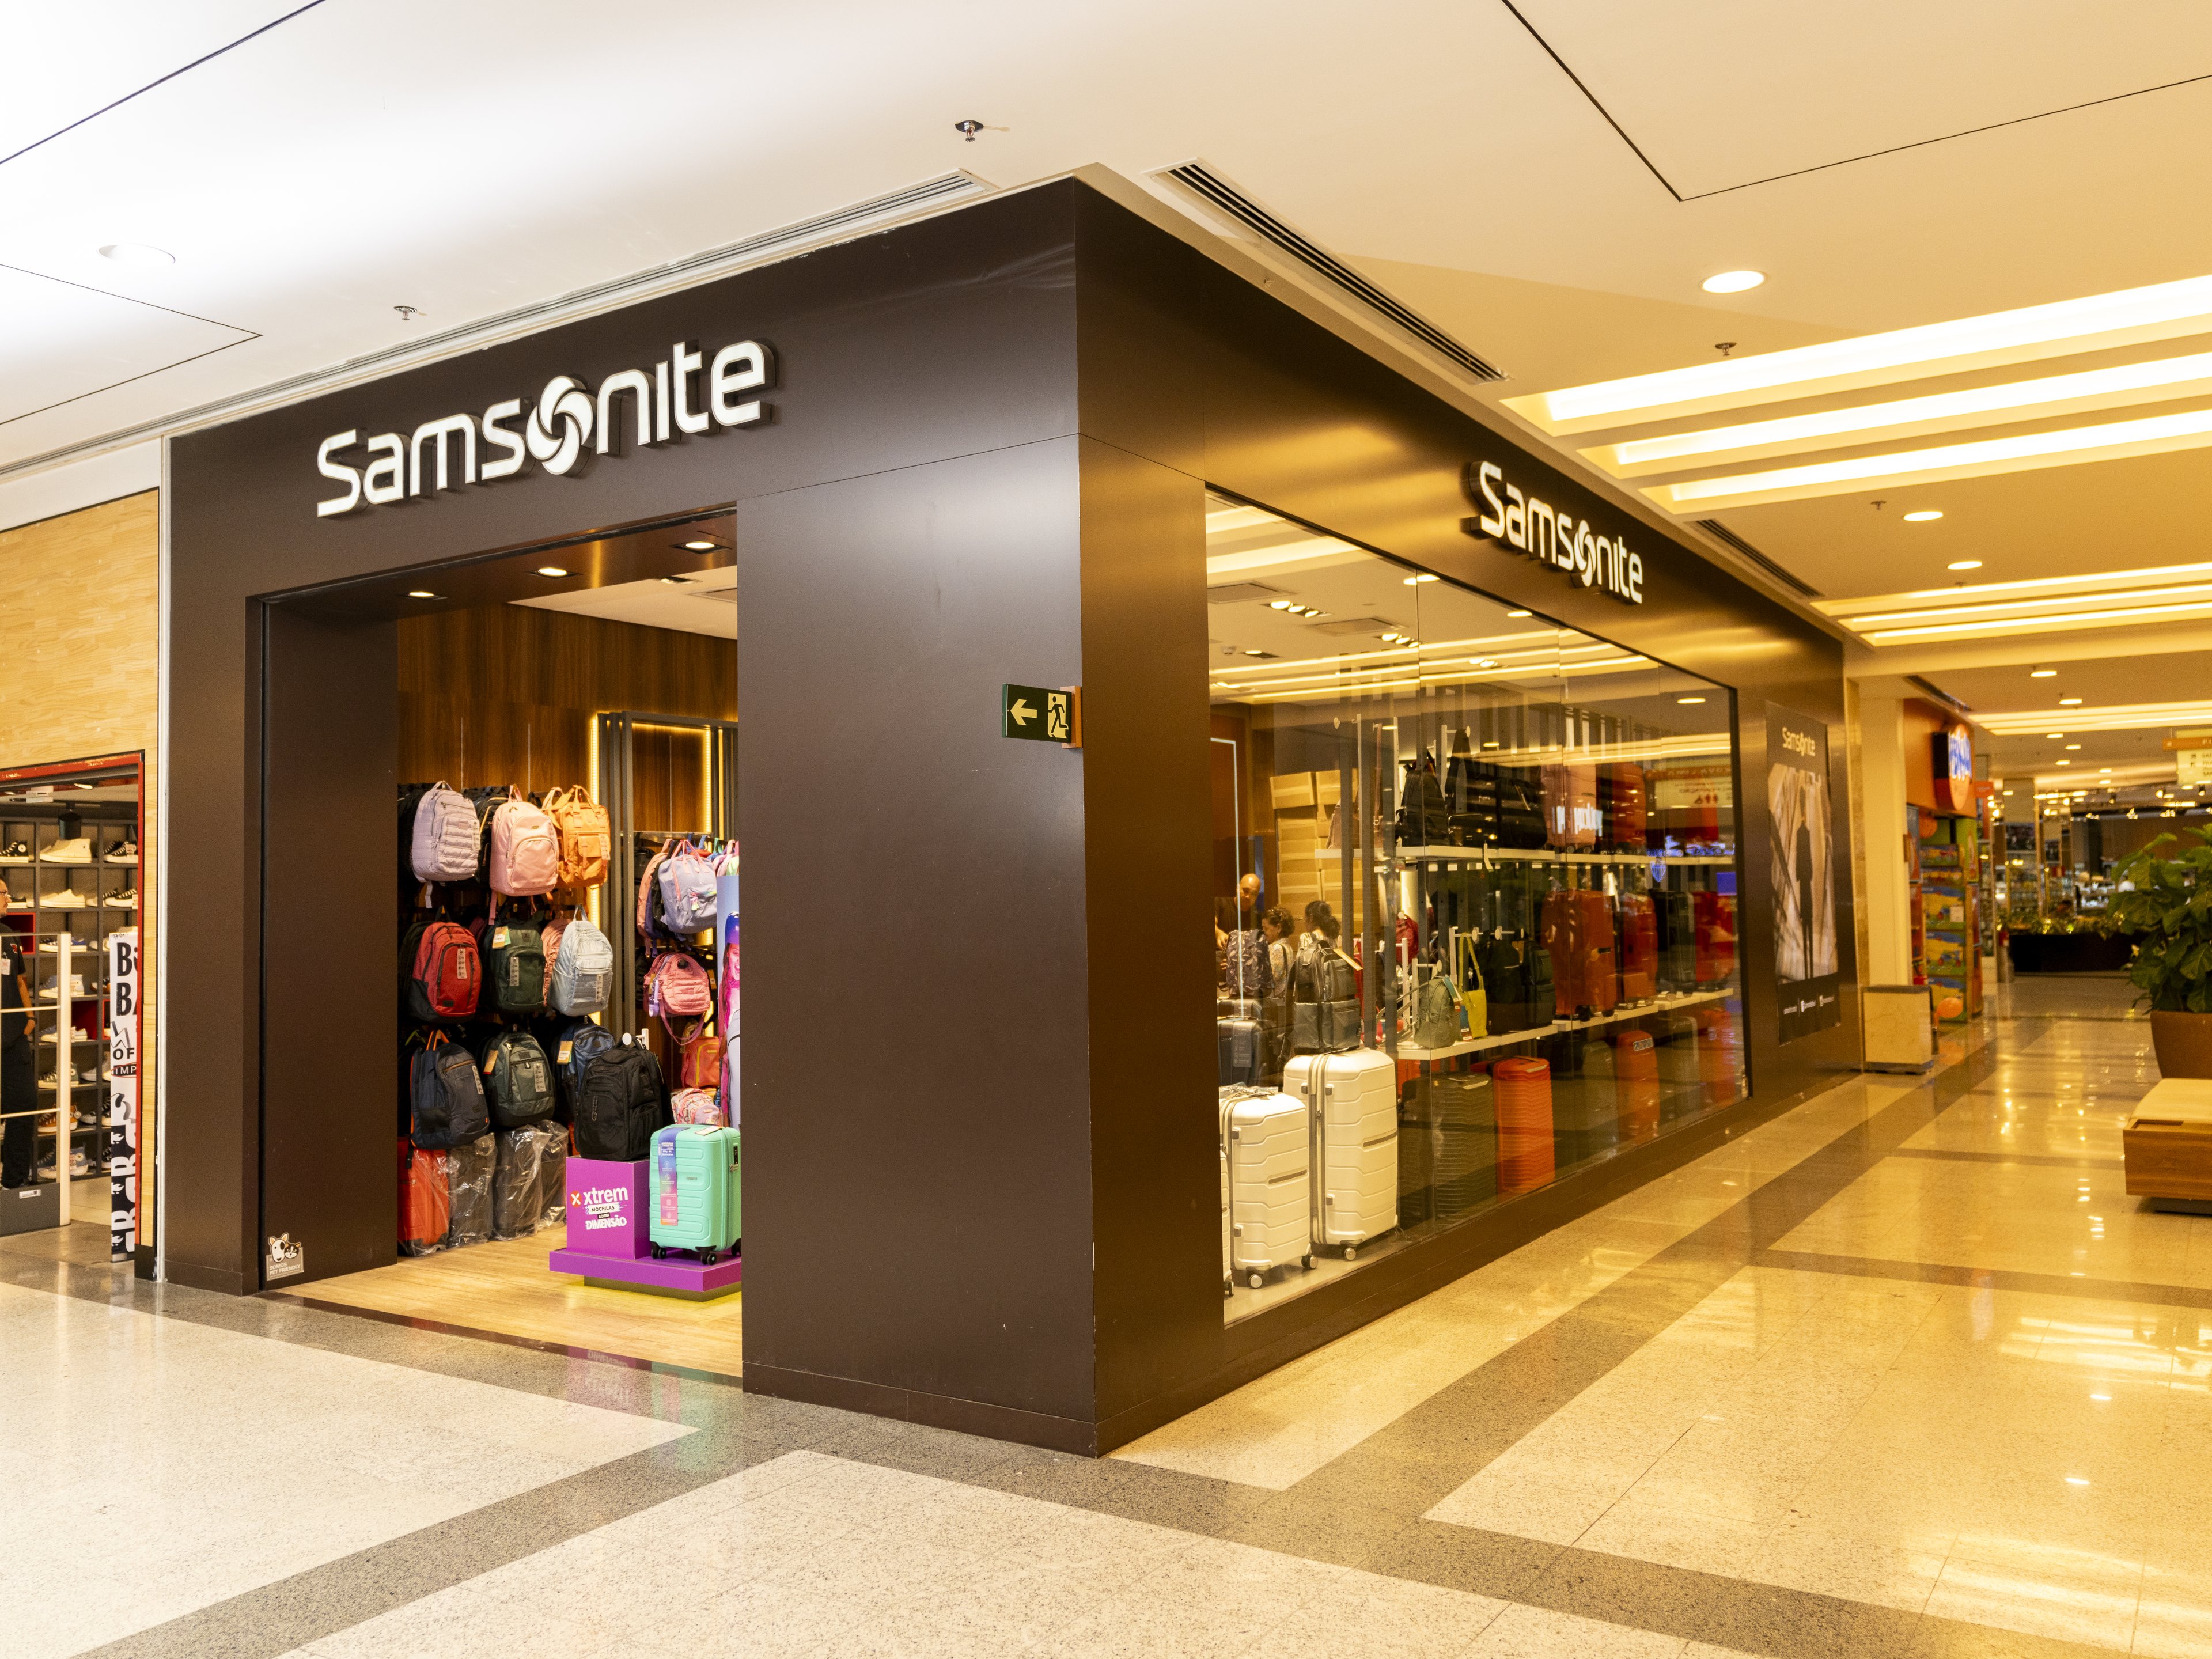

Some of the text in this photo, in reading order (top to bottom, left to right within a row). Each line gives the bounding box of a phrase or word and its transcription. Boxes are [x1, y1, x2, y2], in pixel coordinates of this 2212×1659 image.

[317, 340, 767, 518] Samsonite
[1479, 460, 1643, 604] Samsonite
[1782, 726, 1816, 757] Samsonite
[112, 1047, 135, 1060] OF
[583, 1187, 628, 1205] xtrem
[585, 1214, 627, 1230] DIMENSÃO
[269, 1262, 287, 1271] SOMOS
[279, 1263, 301, 1273] FRIENDLY
